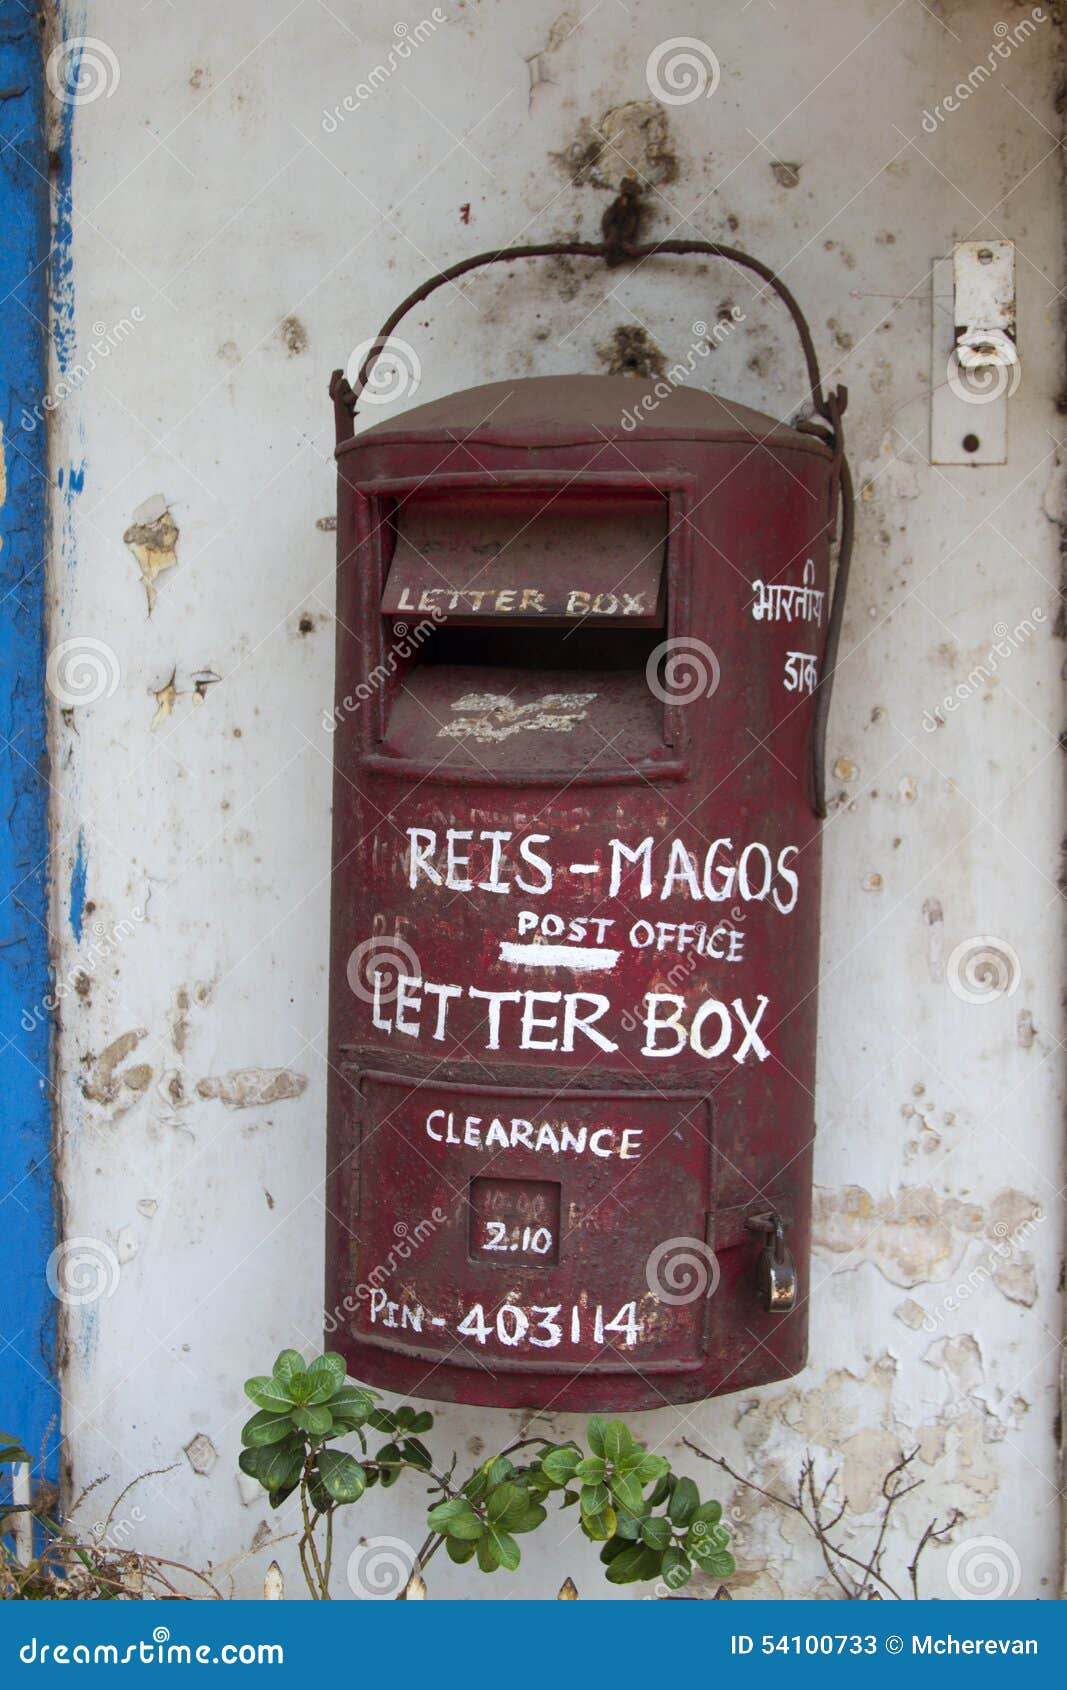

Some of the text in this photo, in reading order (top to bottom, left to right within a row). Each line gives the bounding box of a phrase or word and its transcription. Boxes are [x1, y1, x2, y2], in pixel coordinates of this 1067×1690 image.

[396, 588, 647, 616] LETTER BOX
[752, 558, 825, 628] भारतीय
[783, 651, 818, 696] डाक
[406, 827, 553, 895] REIS
[608, 836, 800, 914] MAGOS
[517, 910, 744, 962] POST OFFICE
[372, 971, 771, 1064] LETTER BOX
[426, 1110, 643, 1160] CLEARANCE
[481, 1221, 553, 1254] 2.10
[456, 1300, 644, 1349] 403114
